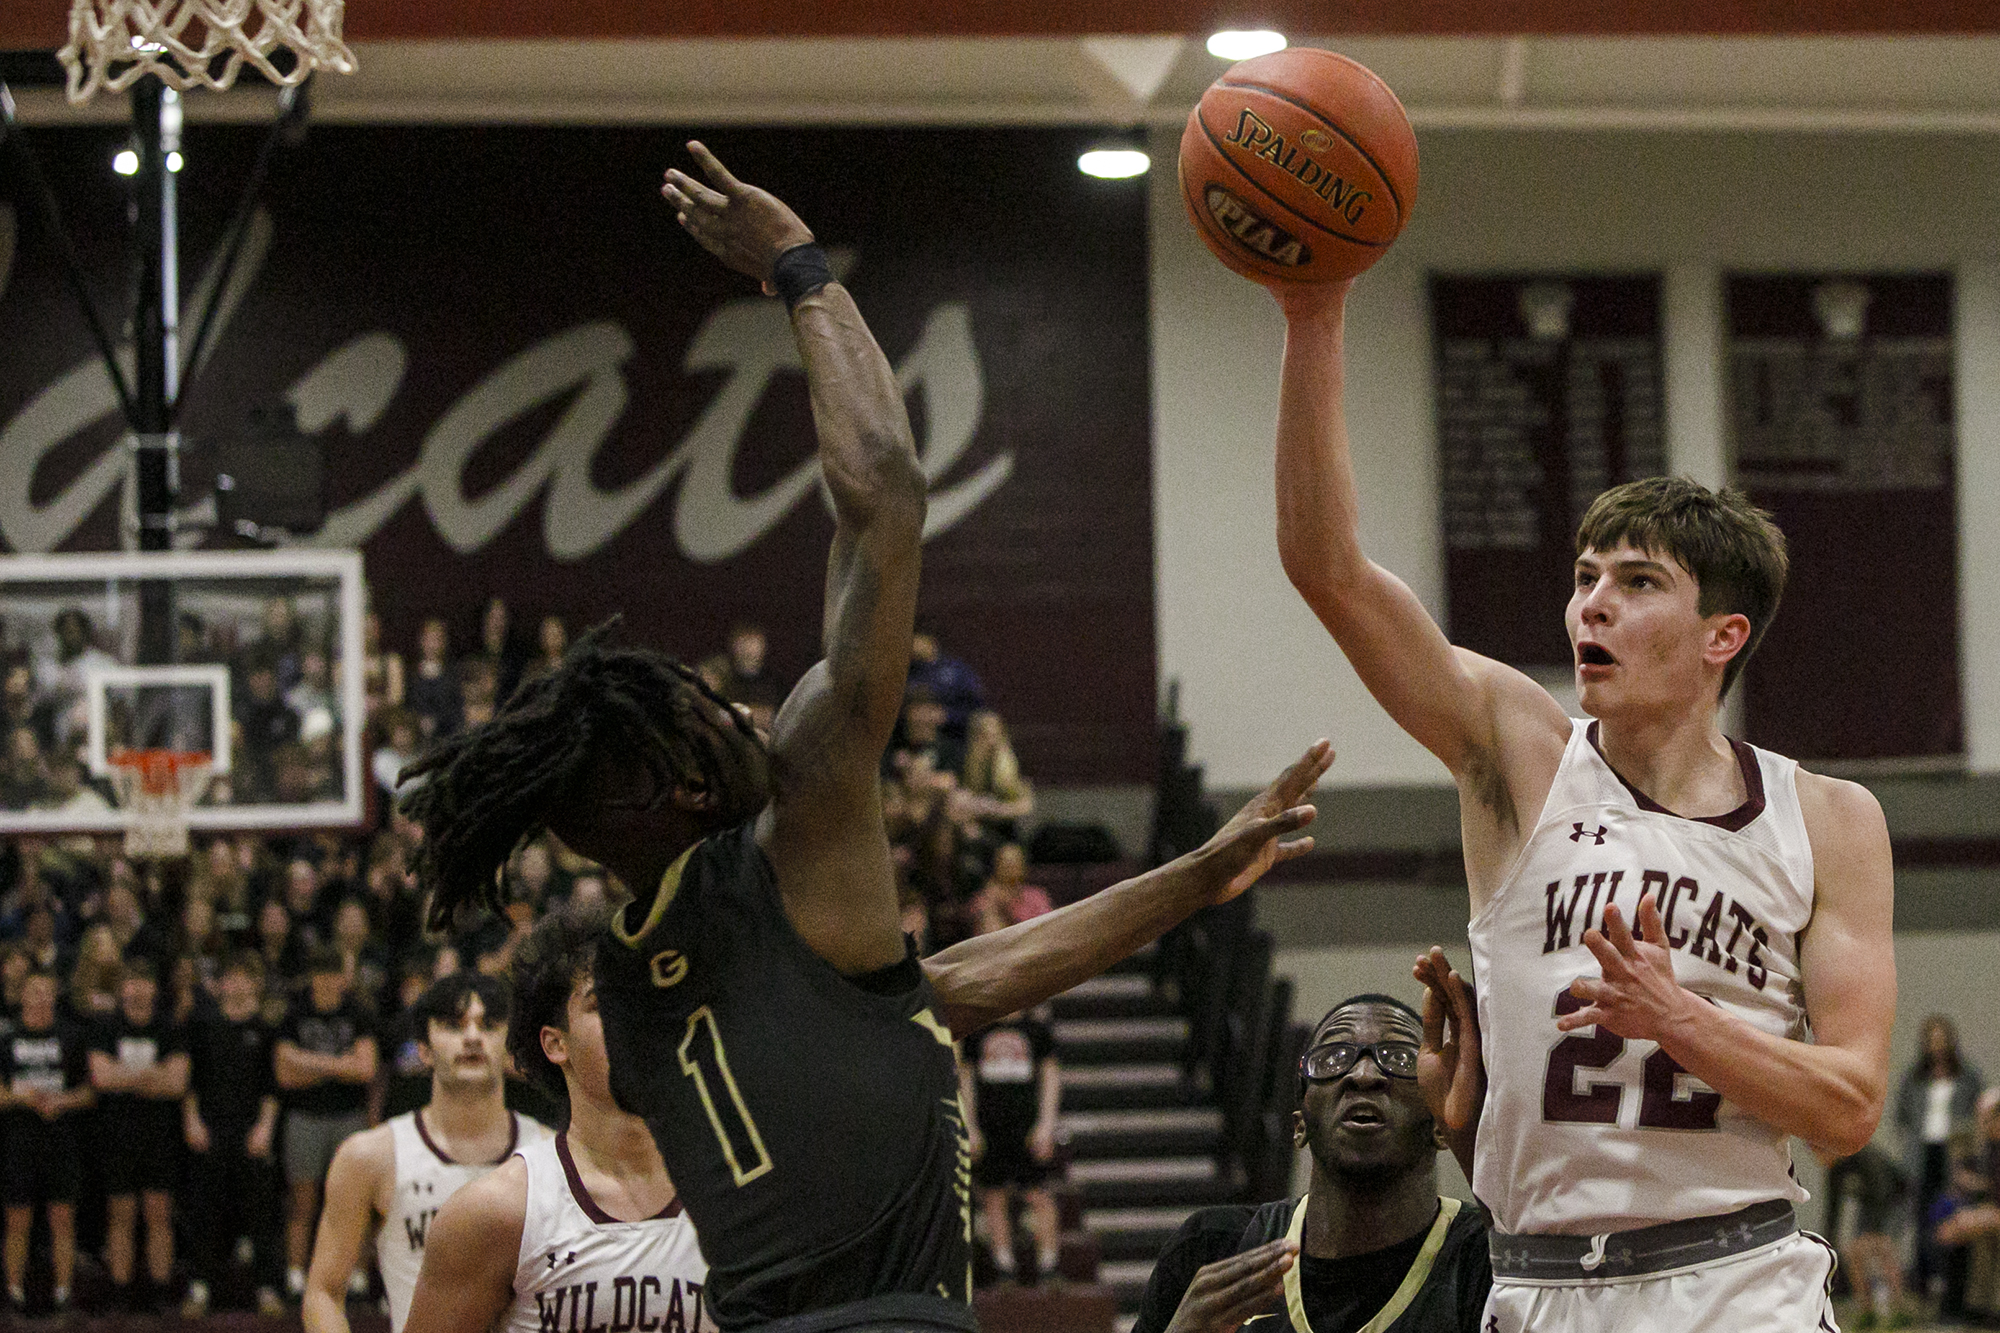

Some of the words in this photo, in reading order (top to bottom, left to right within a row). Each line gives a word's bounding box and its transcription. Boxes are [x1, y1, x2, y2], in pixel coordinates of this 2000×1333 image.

[1225, 107, 1373, 226] SPALDING
[0, 205, 1015, 562] dcats
[650, 949, 689, 988] G
[1542, 868, 1769, 992] WILDCATS
[677, 1004, 775, 1188] 1
